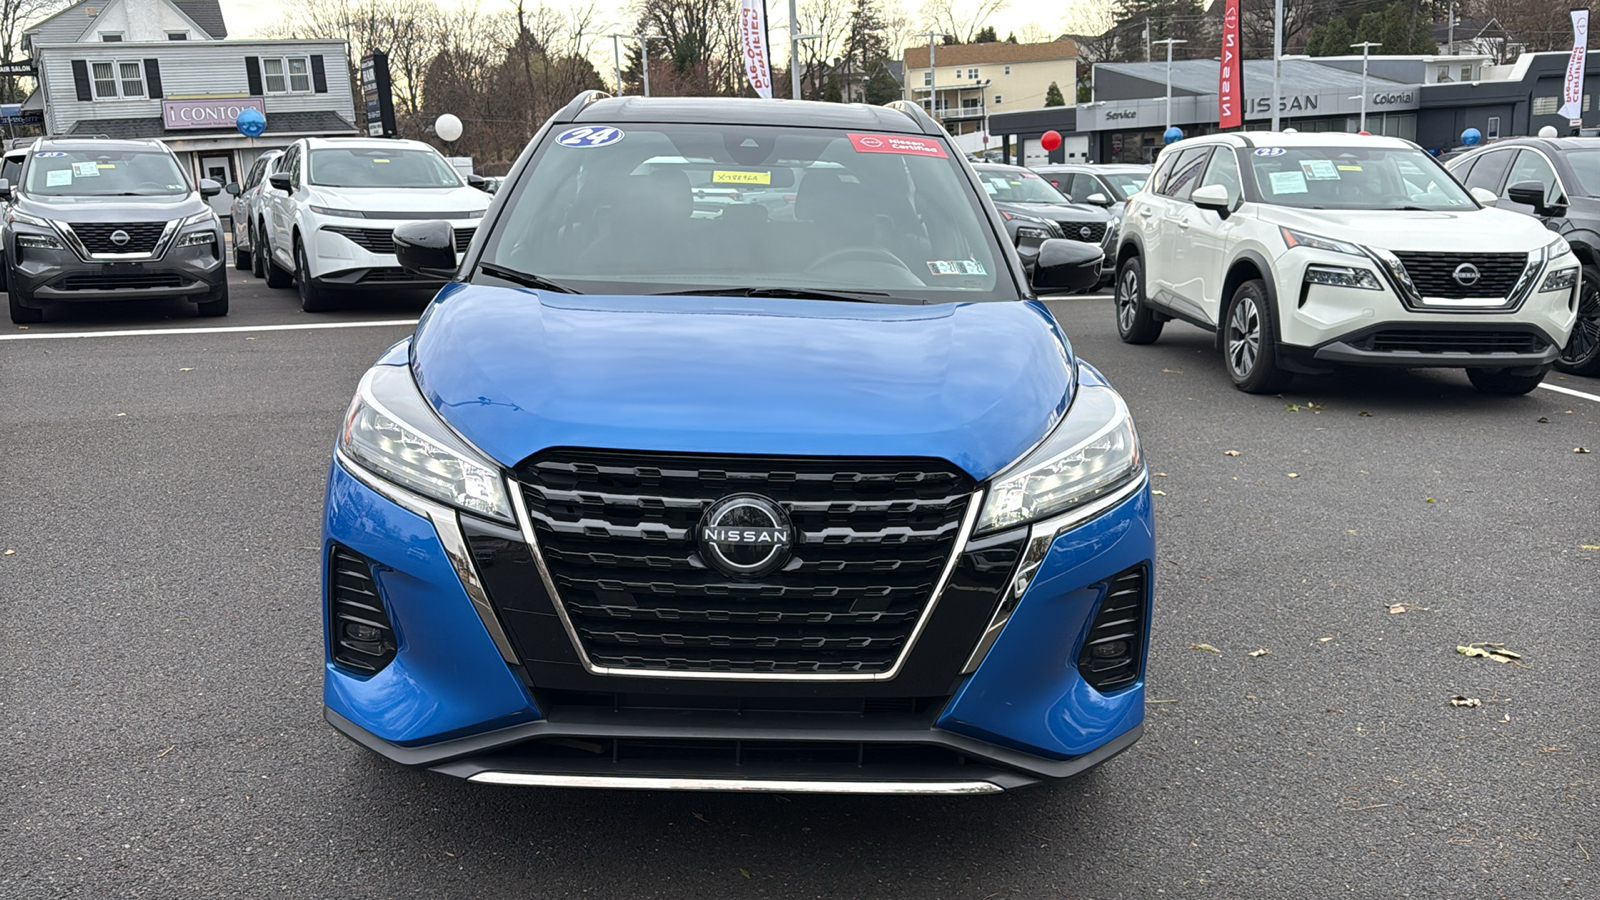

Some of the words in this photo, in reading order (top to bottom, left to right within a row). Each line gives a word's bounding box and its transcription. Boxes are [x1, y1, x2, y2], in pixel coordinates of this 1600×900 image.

[1244, 94, 1318, 113] ISSAN
[1372, 91, 1414, 106] Colonial
[1105, 109, 1137, 121] Service
[561, 128, 617, 144] 24
[888, 138, 925, 147] Nissan
[891, 143, 938, 153] Certified
[1260, 147, 1280, 156] 23
[704, 529, 787, 542] NISSAN
